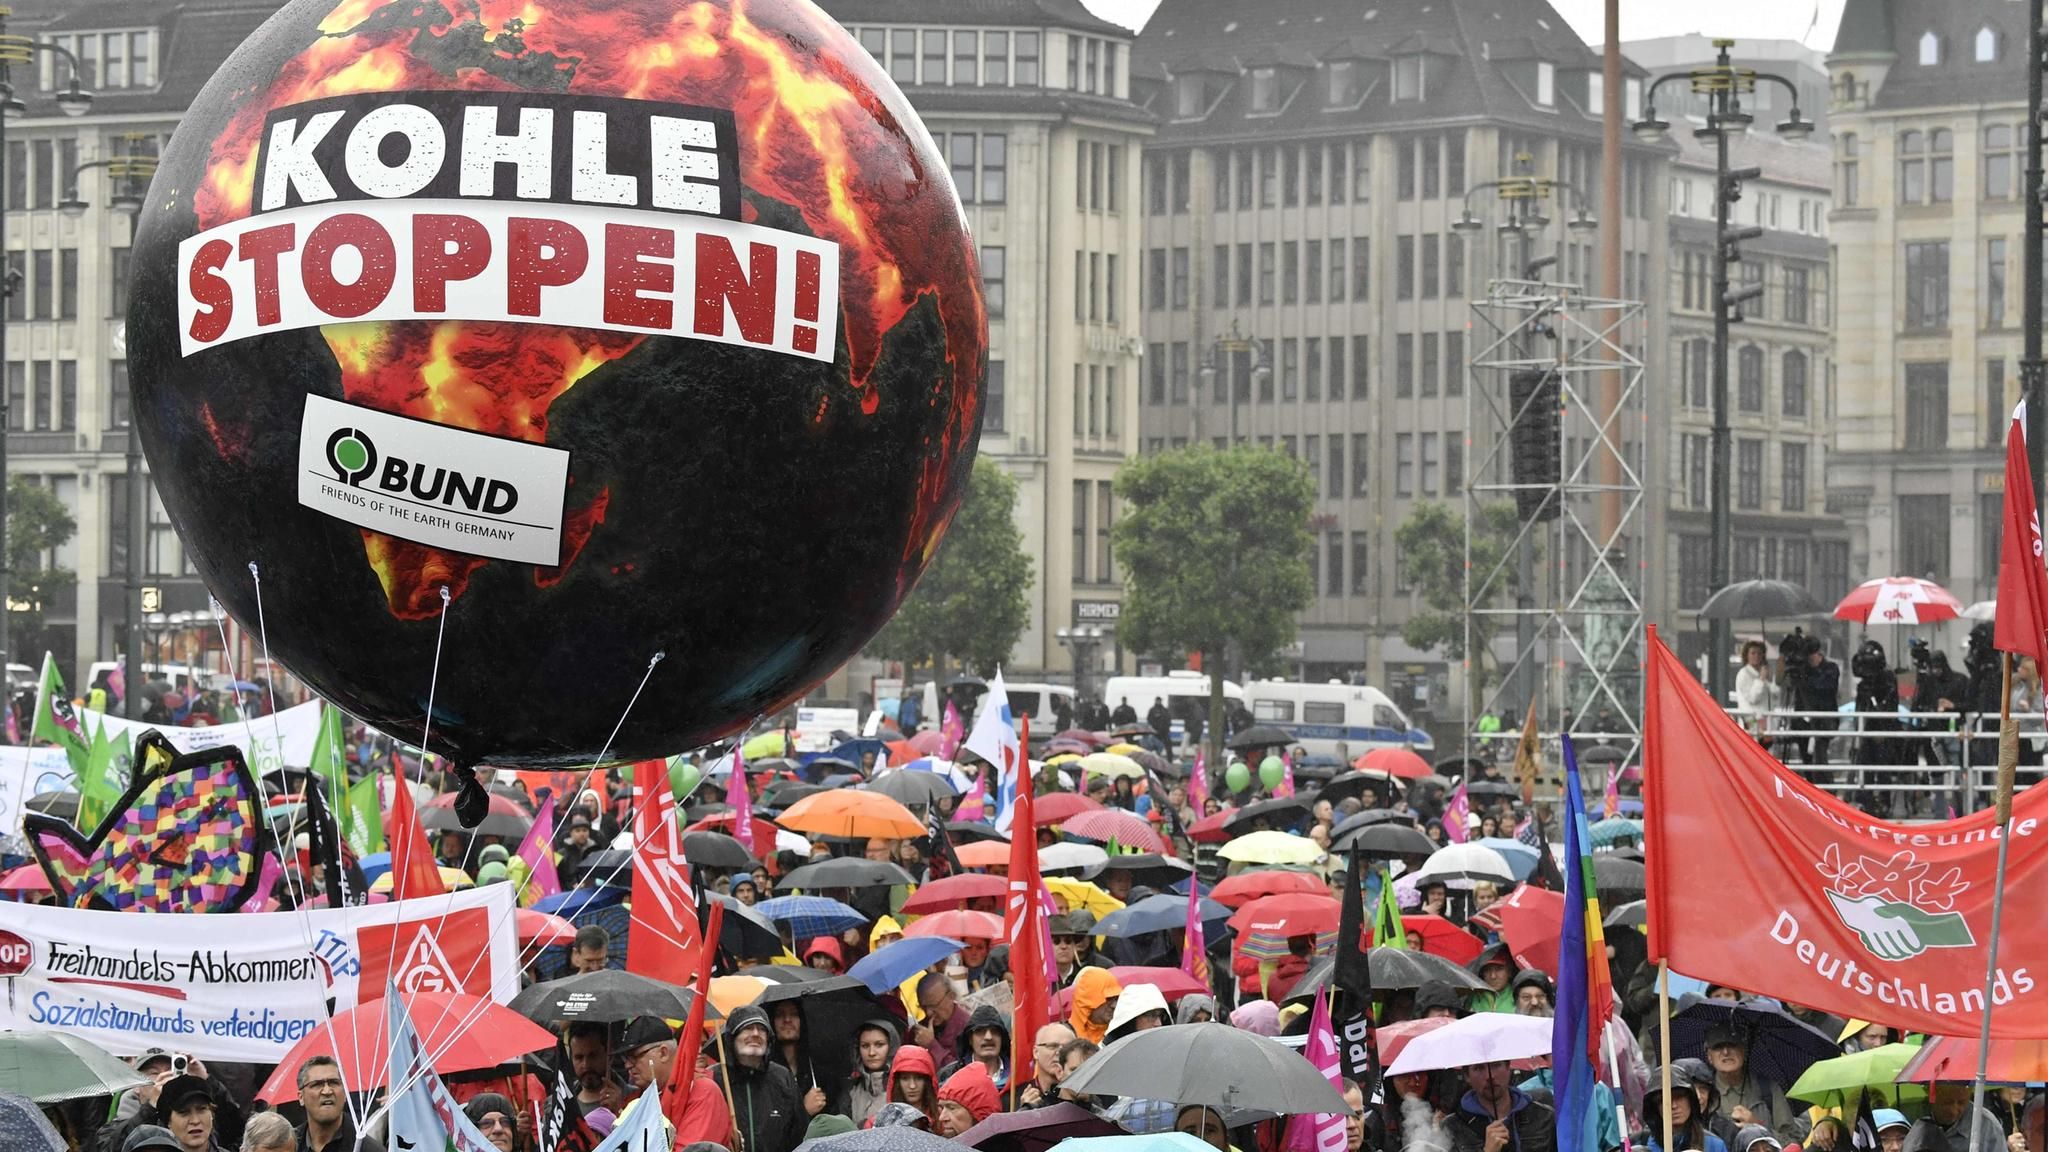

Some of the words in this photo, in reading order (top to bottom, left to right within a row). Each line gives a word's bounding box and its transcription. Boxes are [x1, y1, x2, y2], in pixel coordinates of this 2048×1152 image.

[262, 103, 722, 215] KOHLE
[188, 213, 821, 354] STOPPEN!
[379, 456, 518, 515] BUND
[322, 485, 365, 507] FRIENDS
[371, 498, 384, 512] OF
[389, 504, 409, 519] THE
[414, 511, 450, 529] EARTH
[455, 522, 514, 540] GERMANY
[1079, 603, 1119, 617] HIRMER
[47, 940, 317, 983] Freihandels-Abkommen
[315, 929, 361, 976] TTIP
[1770, 910, 2034, 1014] Deutschlands
[29, 991, 194, 1034] Sozialstandards
[201, 1007, 316, 1043] verteidigen
